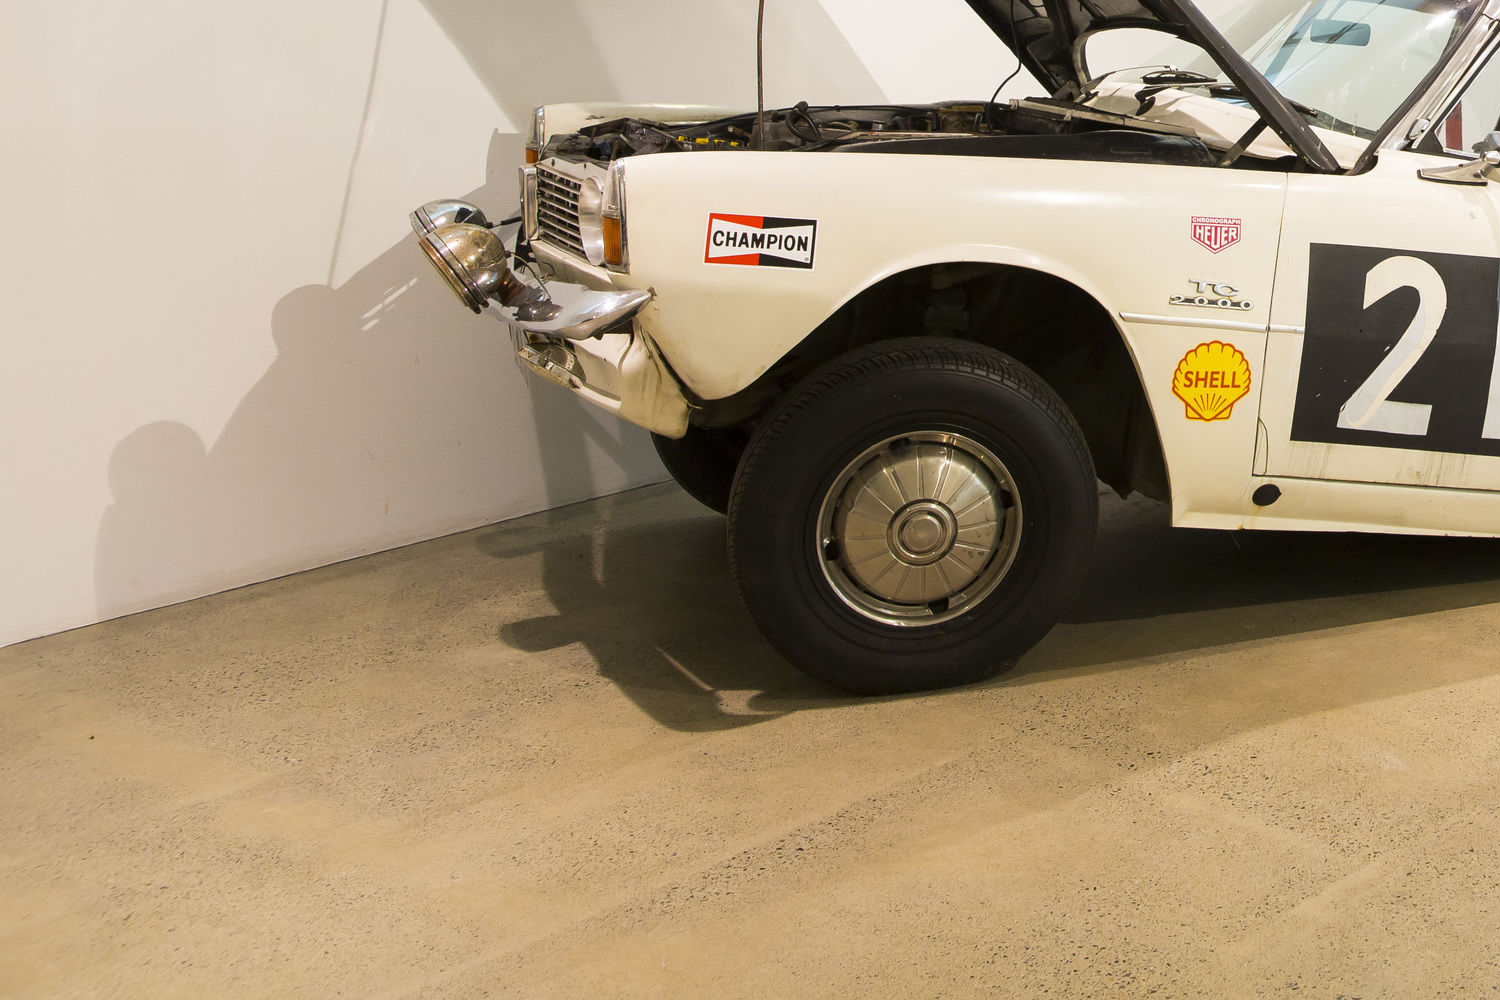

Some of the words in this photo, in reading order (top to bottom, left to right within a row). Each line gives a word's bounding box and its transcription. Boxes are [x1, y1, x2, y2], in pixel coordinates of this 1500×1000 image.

[1192, 216, 1241, 225] CHRONOGRAPH
[712, 230, 809, 252] CHAMPION
[1195, 225, 1238, 250] HEUER
[1188, 278, 1240, 297] TC
[1169, 294, 1254, 311] 2000
[1183, 370, 1241, 389] SHELL
